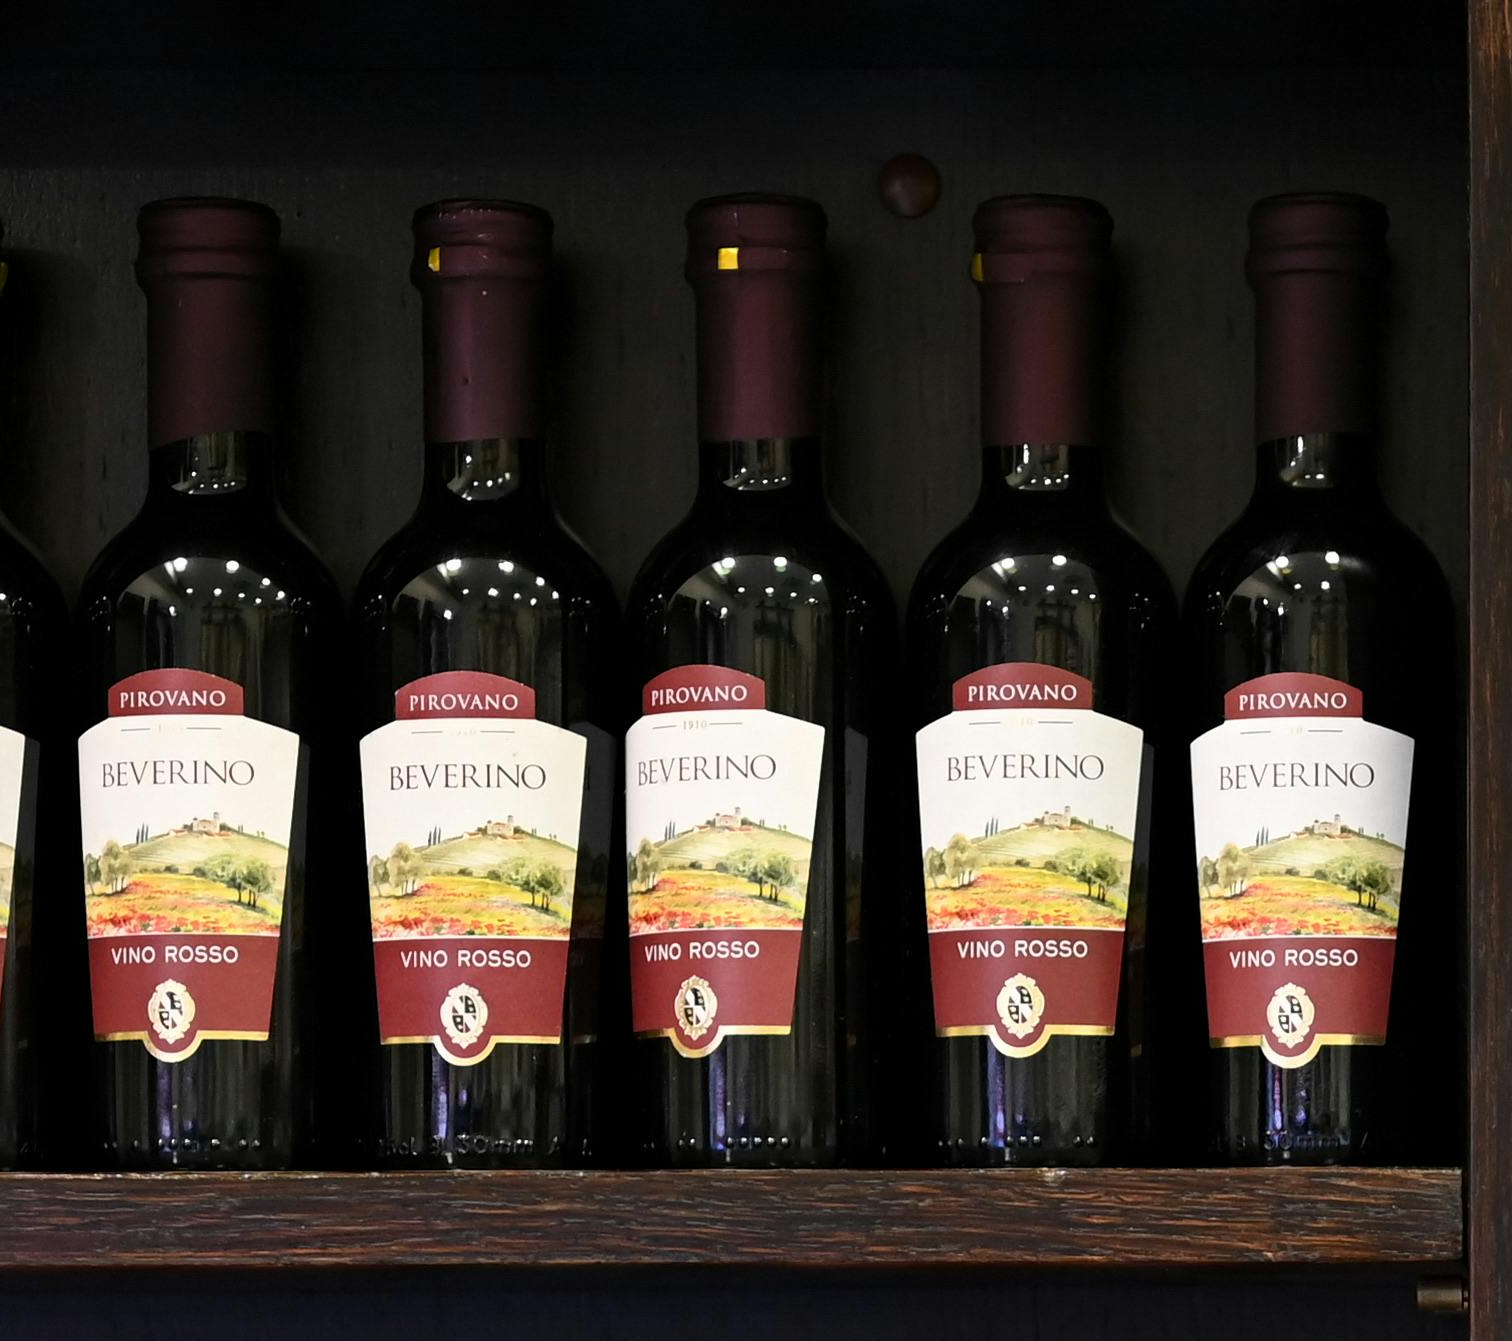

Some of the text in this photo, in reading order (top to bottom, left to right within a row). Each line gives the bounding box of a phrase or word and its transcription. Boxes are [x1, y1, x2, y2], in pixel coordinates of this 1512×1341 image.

[120, 691, 226, 709] PIROVANO
[966, 684, 1077, 702] PIROVANO
[101, 760, 256, 788] BEVERINO
[945, 753, 1106, 782] BEVERINO
[111, 947, 239, 964] VINO ROSSO
[957, 940, 1088, 959] VINO ROSSO
